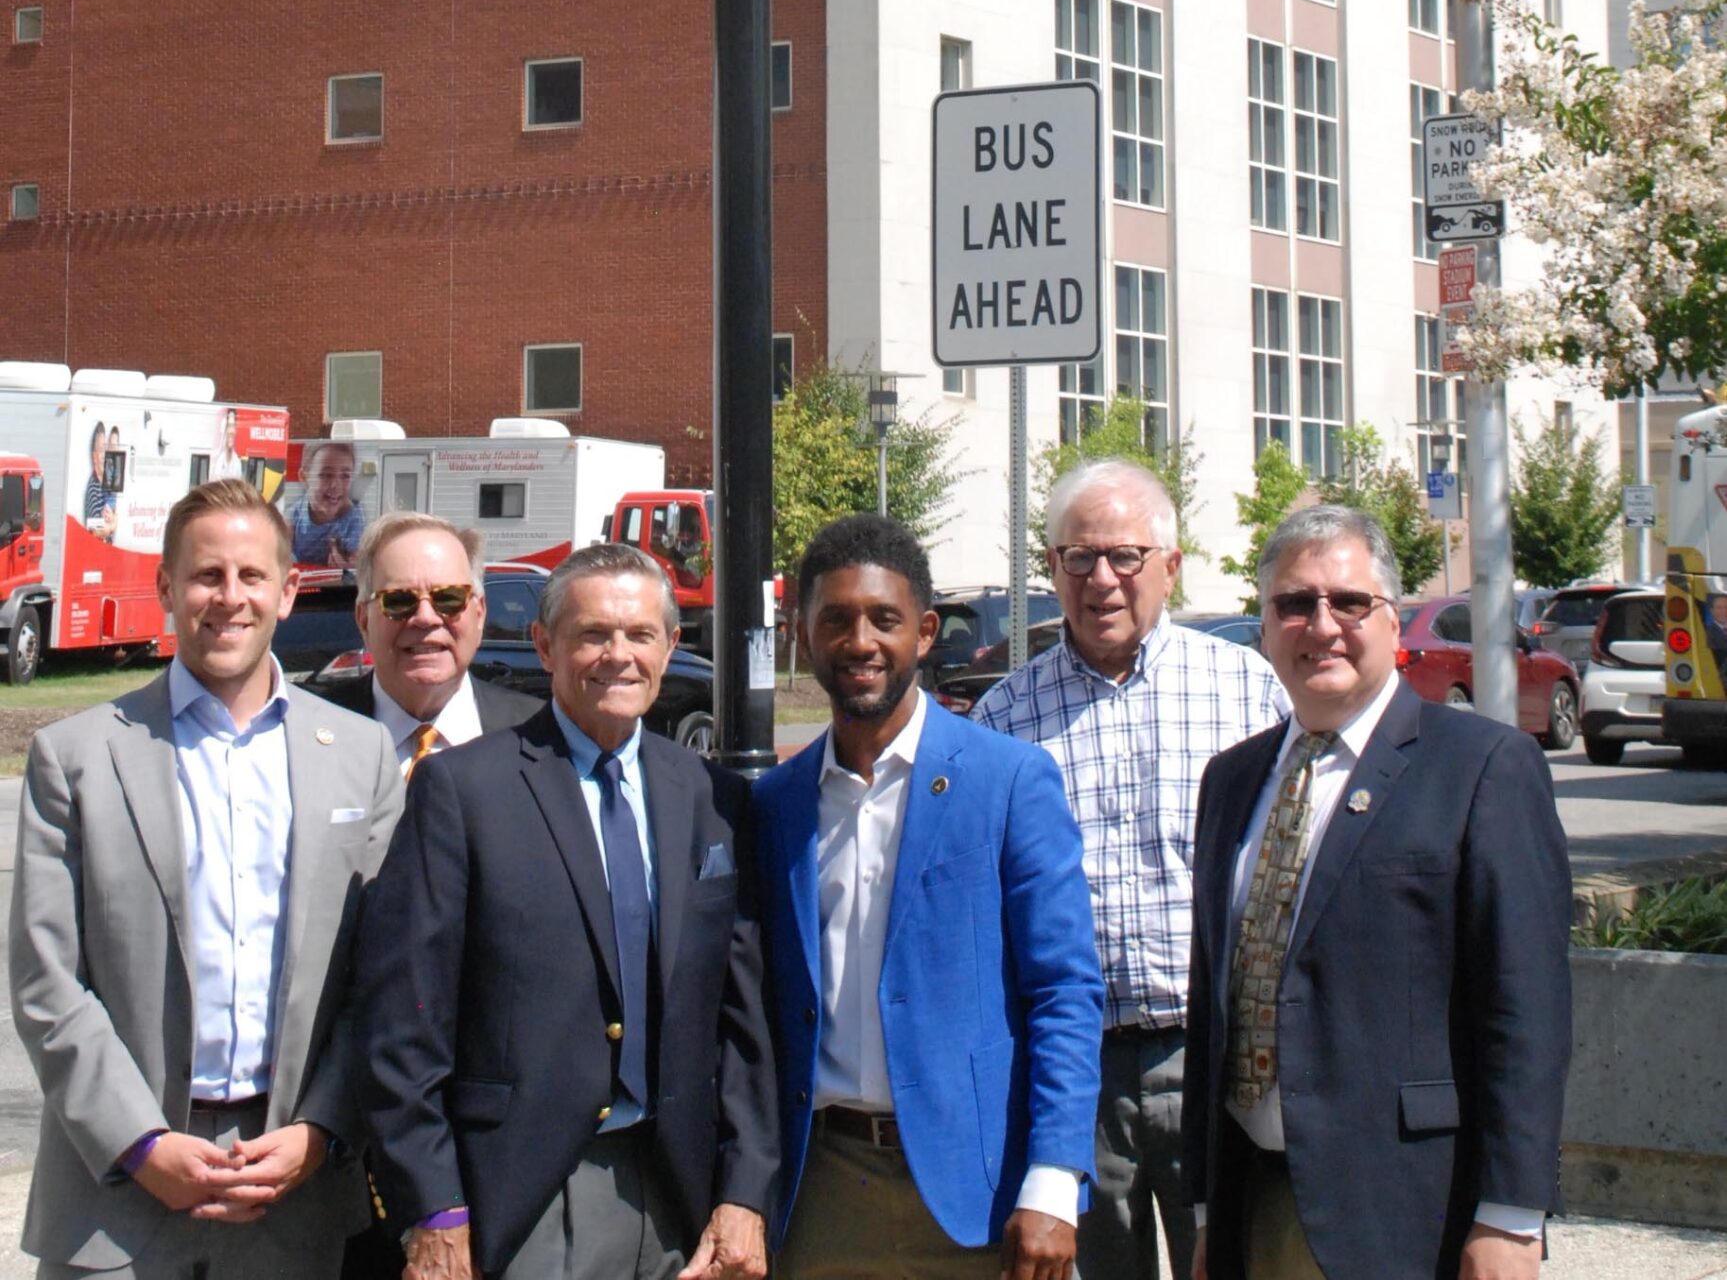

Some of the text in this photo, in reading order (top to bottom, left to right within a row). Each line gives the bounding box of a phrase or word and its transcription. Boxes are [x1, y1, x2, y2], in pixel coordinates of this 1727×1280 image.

[975, 121, 1054, 172] BUS
[1431, 125, 1457, 137] SNOW
[1450, 139, 1475, 157] NO
[963, 199, 1066, 251] LANE
[949, 278, 1083, 330] AHEAD
